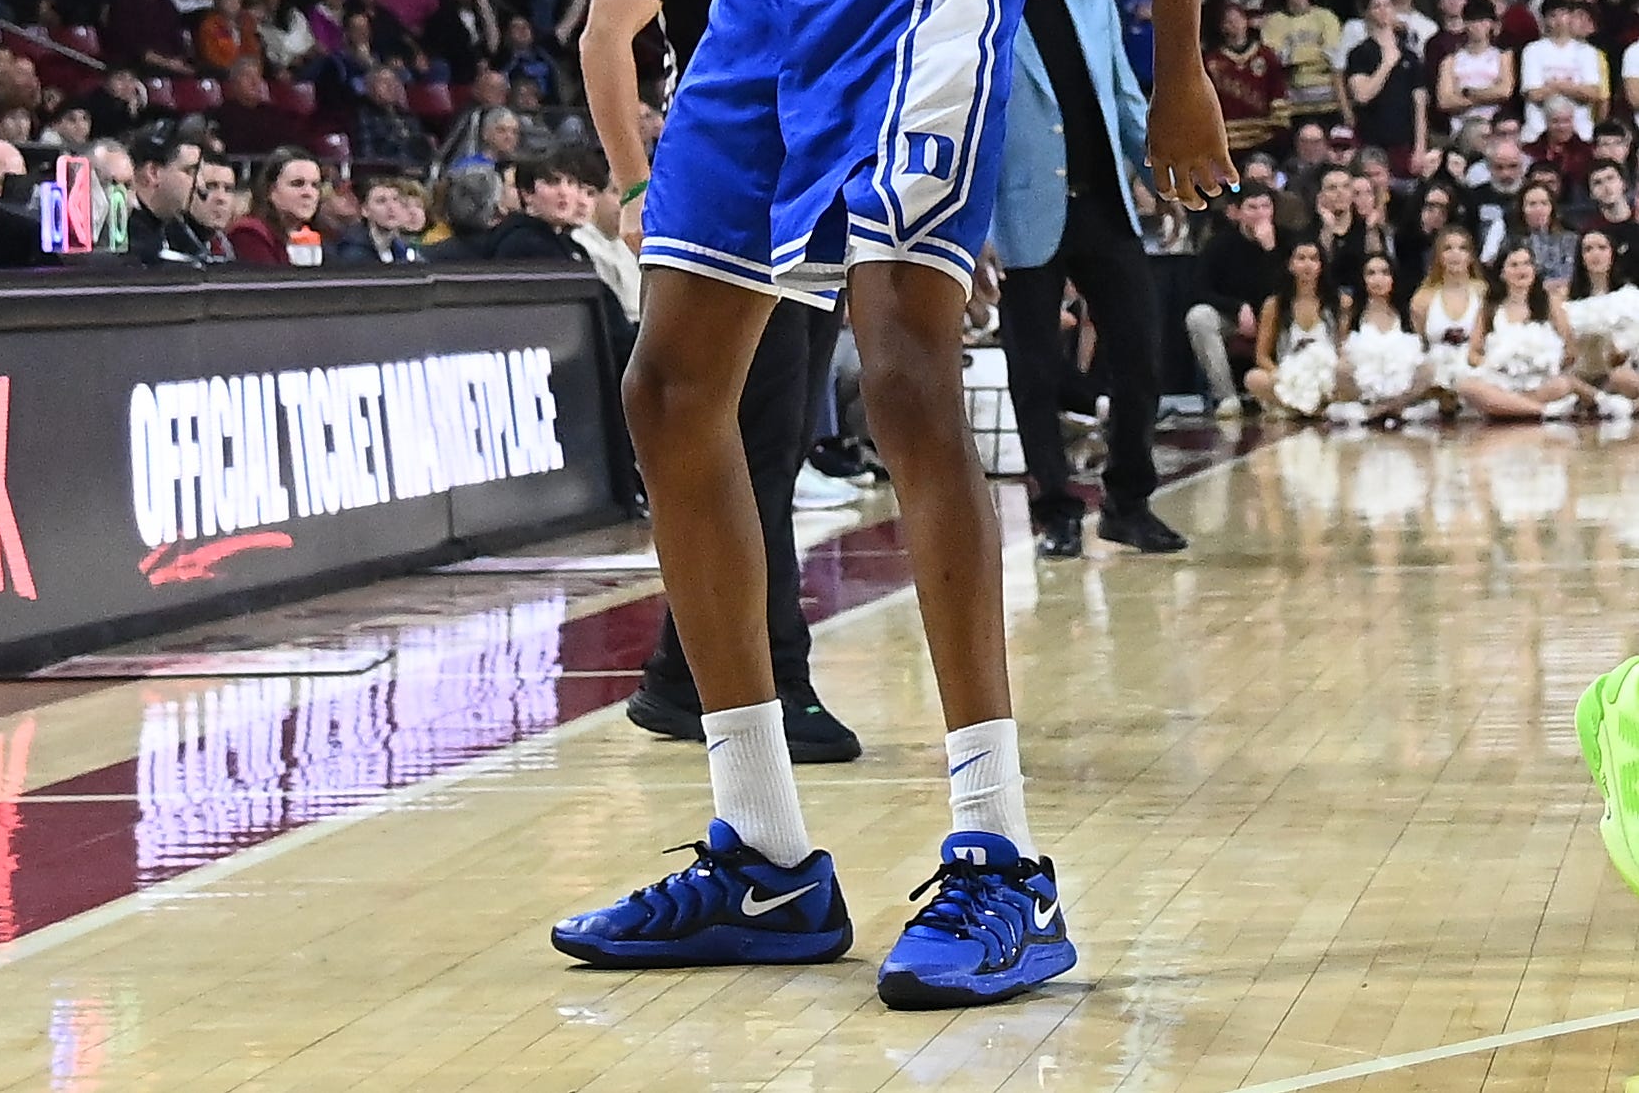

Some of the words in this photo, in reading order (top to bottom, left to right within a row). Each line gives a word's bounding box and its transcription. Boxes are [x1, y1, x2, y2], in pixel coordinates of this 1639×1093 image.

[901, 131, 955, 181] D
[130, 372, 290, 547] OFFICIAL
[278, 364, 390, 518] TICKET
